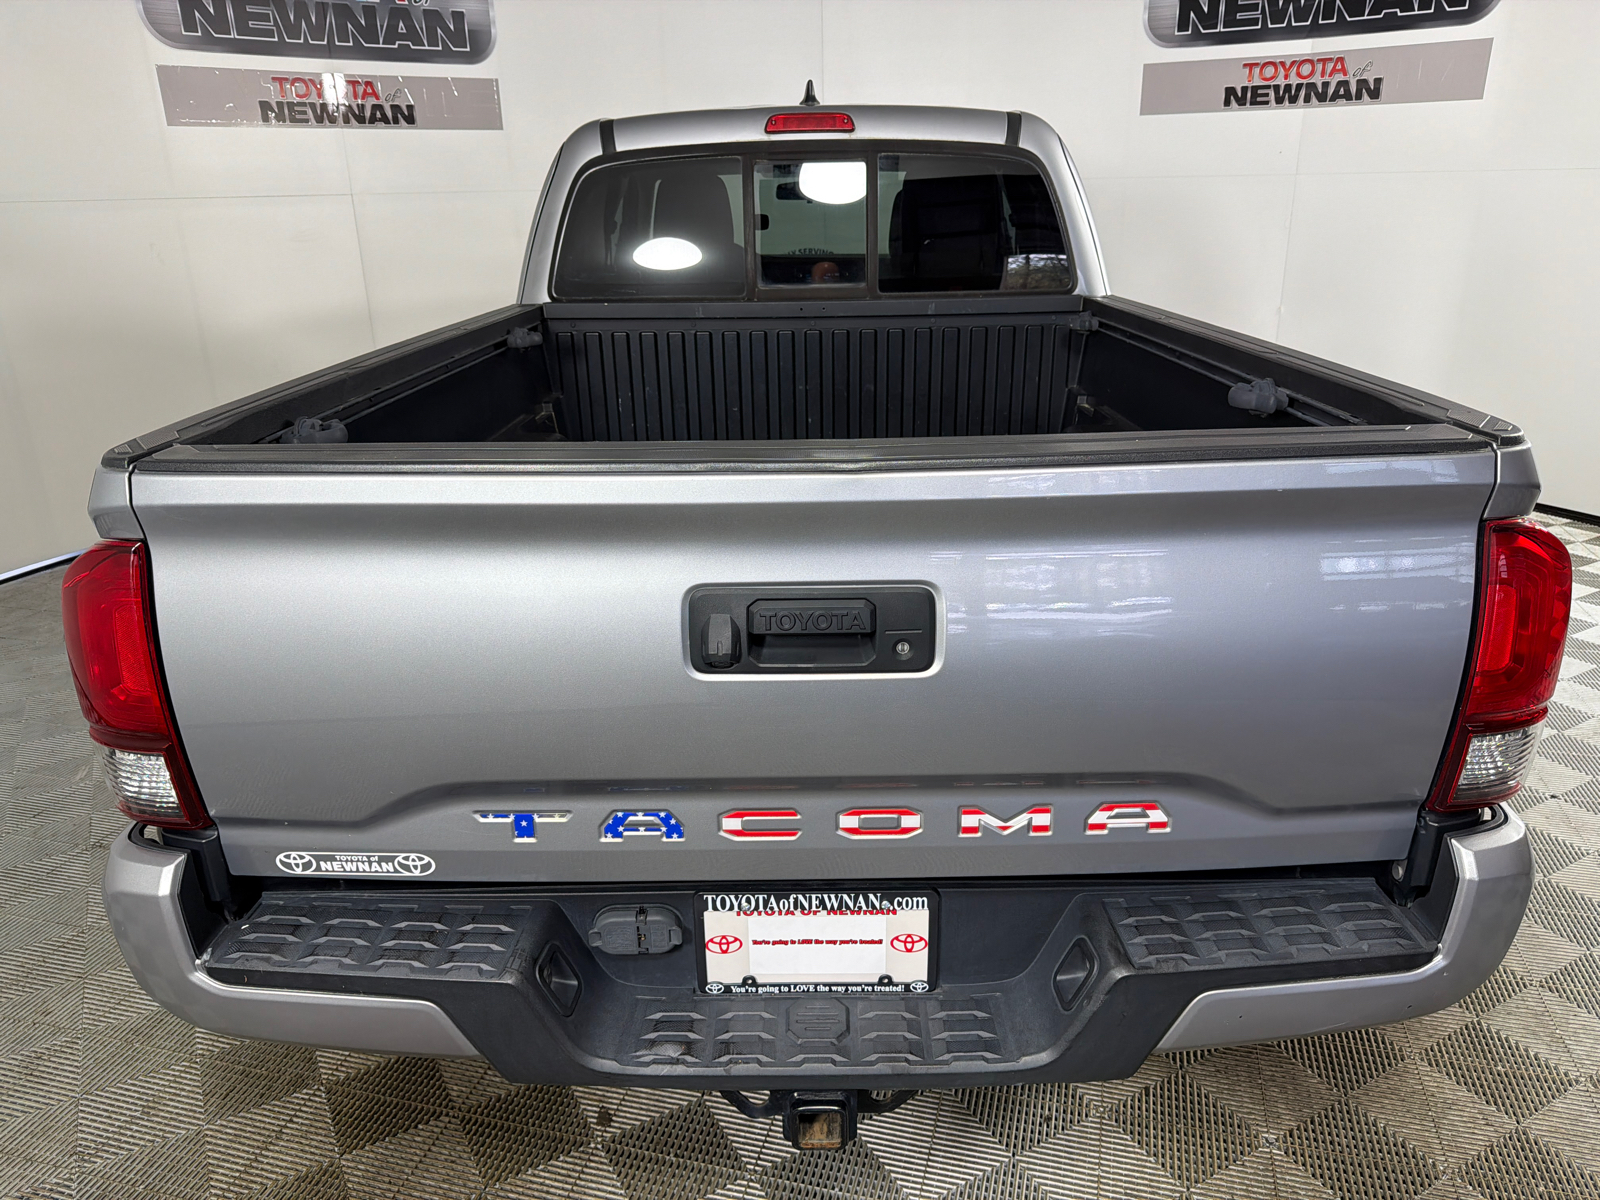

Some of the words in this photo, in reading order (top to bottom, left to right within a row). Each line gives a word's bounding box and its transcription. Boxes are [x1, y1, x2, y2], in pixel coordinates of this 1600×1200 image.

[177, 0, 470, 51] NEWNAN
[1175, 0, 1470, 34] NEWN
[1242, 56, 1349, 83] TOYOTA
[1352, 60, 1373, 78] of
[271, 76, 381, 101] TOYTA
[384, 88, 402, 104] of
[1223, 76, 1384, 107] NEWNAN
[258, 100, 416, 126] NEWNAN
[759, 610, 867, 632] TOYOTA
[473, 801, 1173, 843] TACOMA
[319, 861, 395, 873] NEWNAN
[731, 985, 757, 993] You're
[757, 985, 780, 993] going
[790, 984, 815, 992] LOVE
[831, 985, 846, 993] way
[847, 984, 873, 993] you're
[874, 984, 905, 992] treated!
